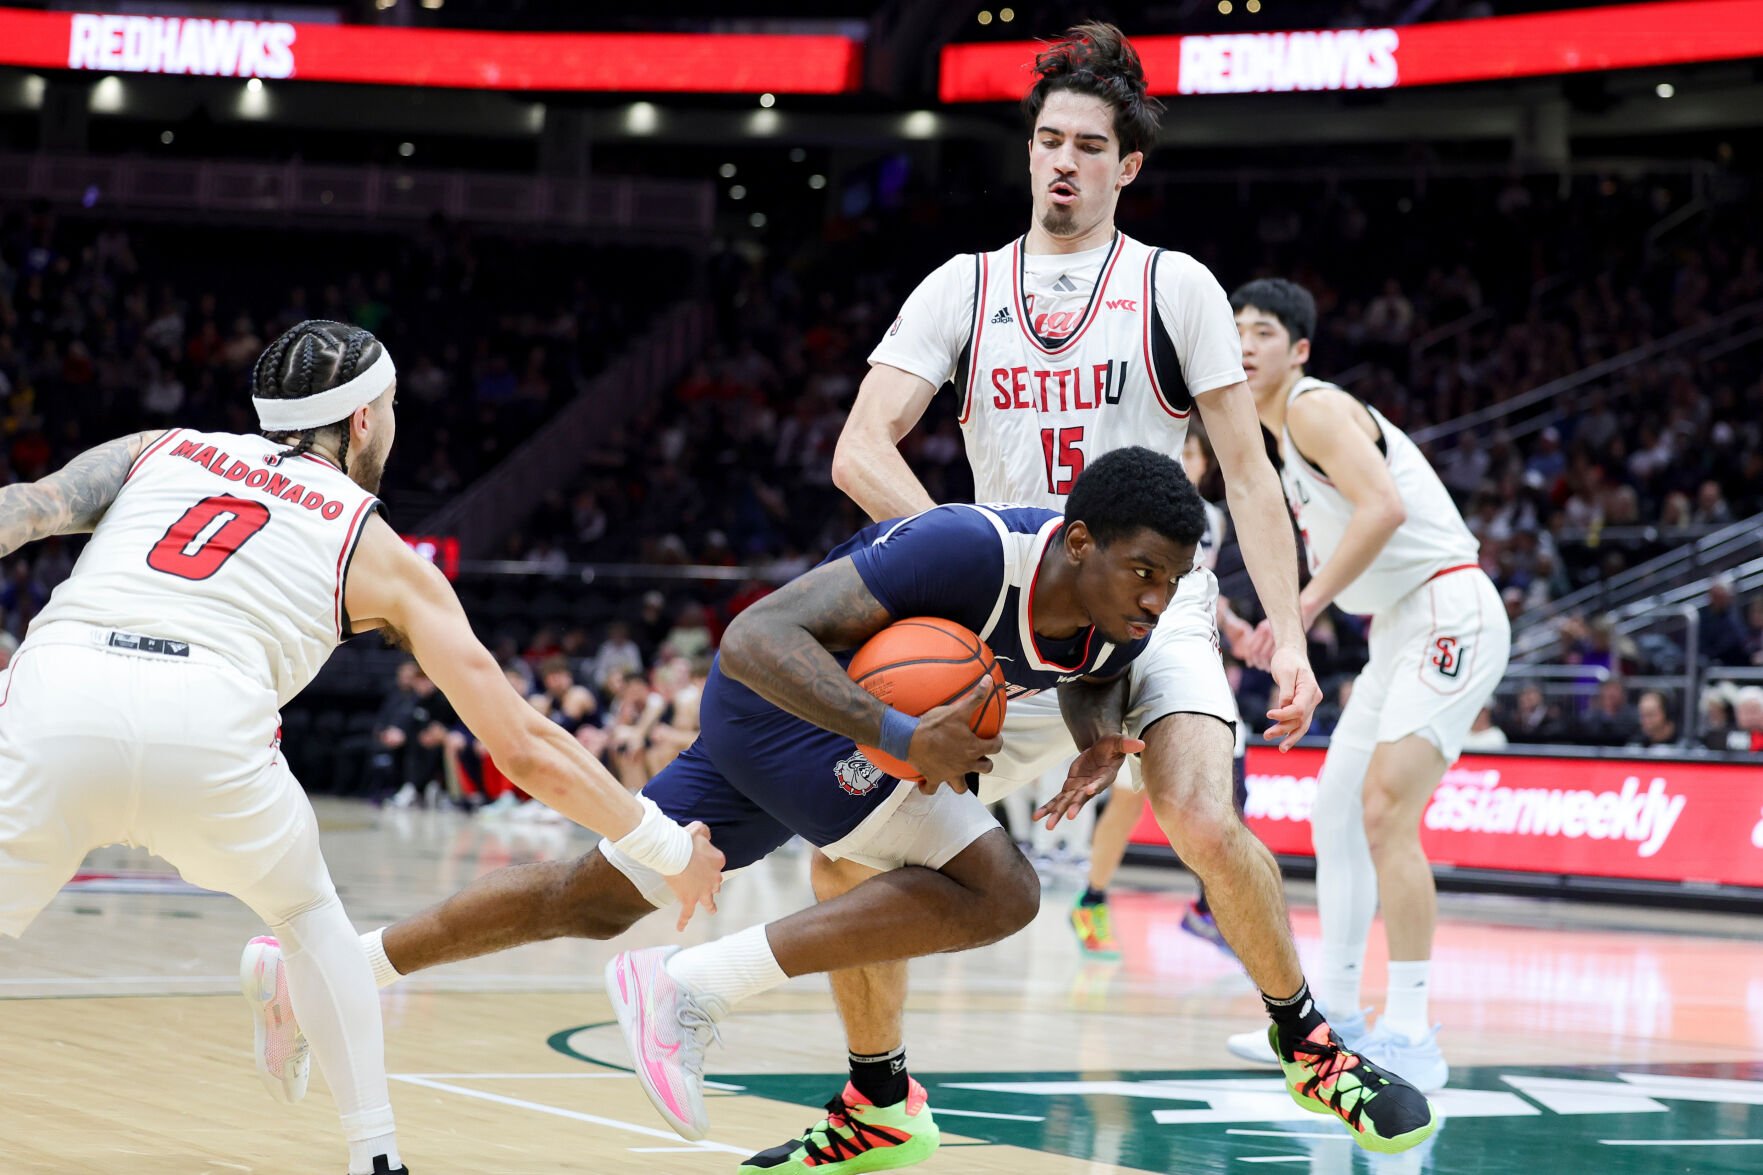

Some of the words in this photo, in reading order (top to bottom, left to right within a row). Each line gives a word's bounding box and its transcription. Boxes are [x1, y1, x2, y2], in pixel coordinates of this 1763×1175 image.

[68, 13, 297, 79] REDHAWKS
[1178, 28, 1400, 94] REDHAWKS
[1105, 299, 1137, 312] WCC
[169, 439, 344, 521] MALDONADO
[1040, 425, 1085, 496] 15
[146, 493, 272, 582] 0
[1424, 769, 1688, 858] asianweekly
